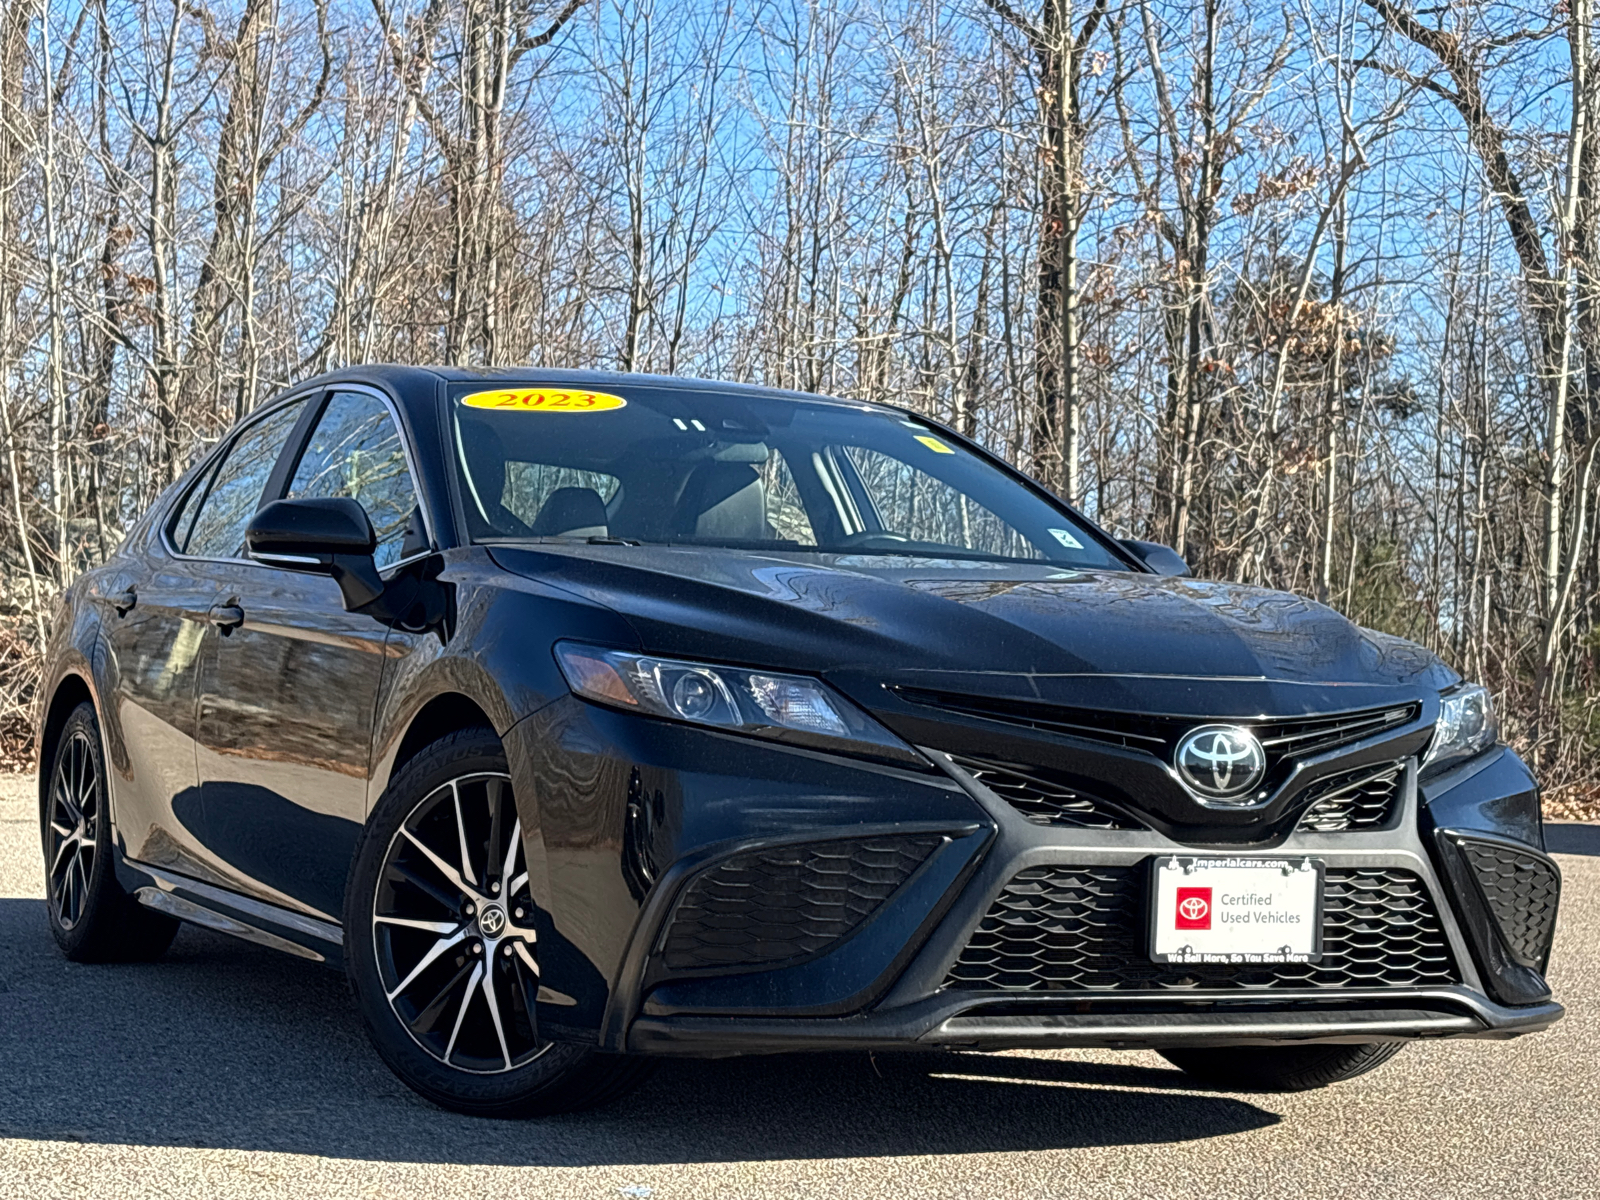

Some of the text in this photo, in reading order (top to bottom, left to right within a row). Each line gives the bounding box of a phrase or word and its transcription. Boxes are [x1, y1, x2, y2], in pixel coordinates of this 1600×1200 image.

[496, 393, 596, 407] 2023
[1192, 858, 1288, 869] Imperialcars.com
[1221, 893, 1272, 905] Certified
[1221, 911, 1301, 923] Used Vehicles
[1167, 953, 1308, 965] We Sell More, So You Save More
[423, 1043, 575, 1098] ASTERCRAFT
